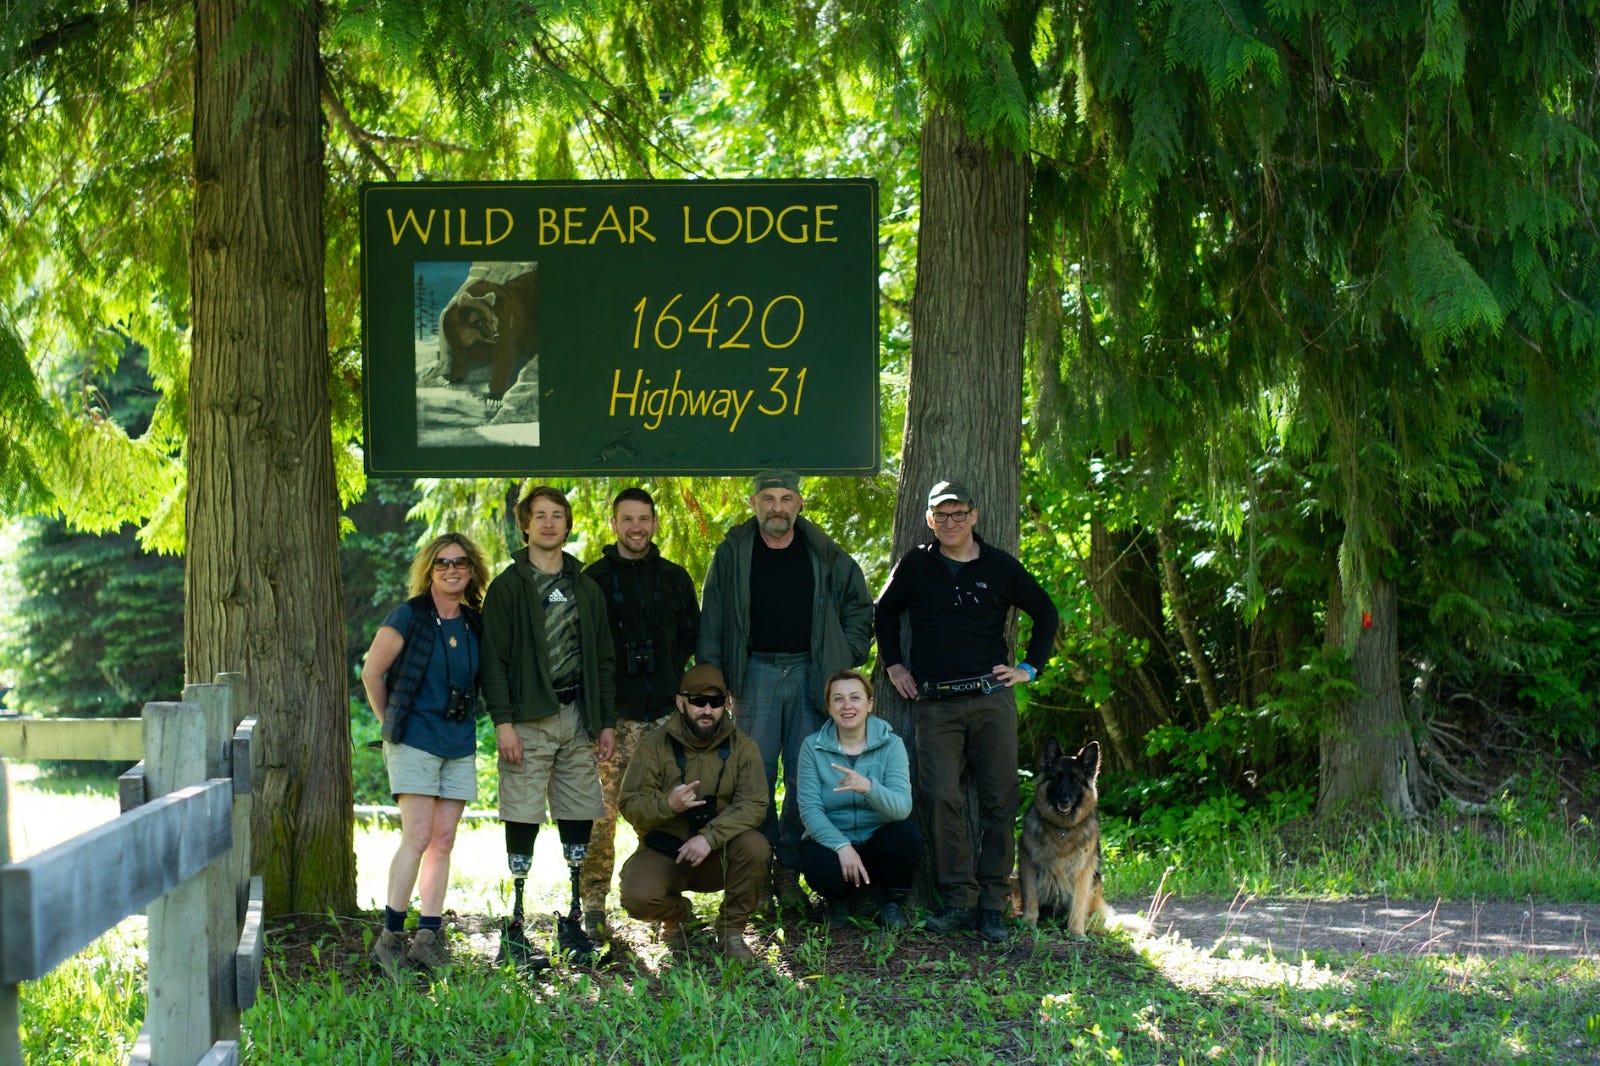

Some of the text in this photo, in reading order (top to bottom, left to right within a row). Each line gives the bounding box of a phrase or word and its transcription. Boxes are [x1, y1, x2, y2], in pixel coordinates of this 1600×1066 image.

[386, 204, 839, 246] WILD BEAR LODGE
[633, 292, 805, 350] 16420
[608, 367, 808, 433] Highway 31
